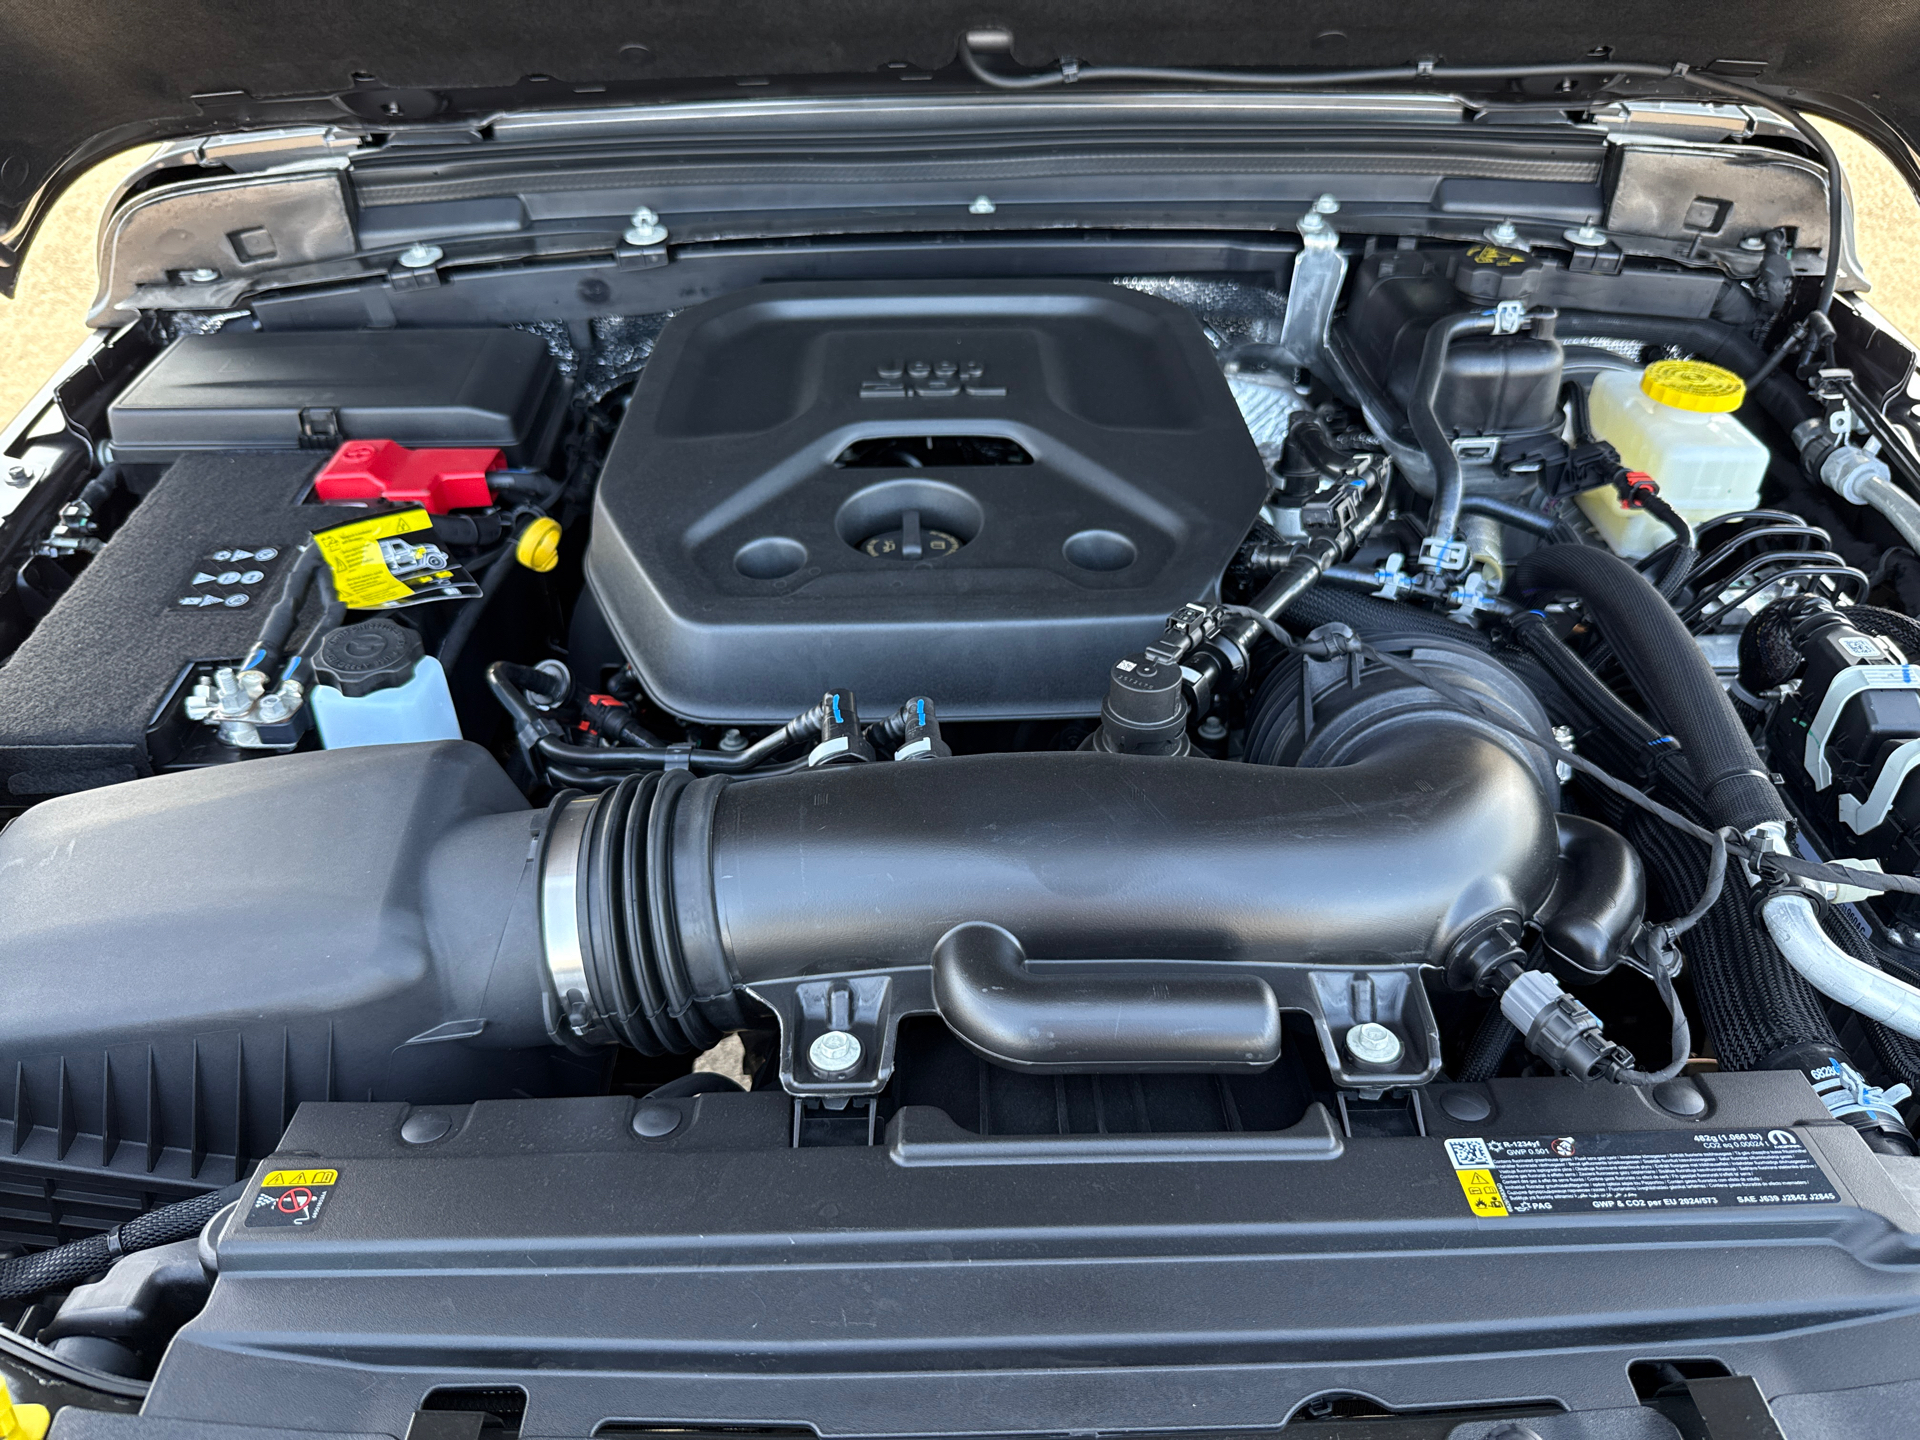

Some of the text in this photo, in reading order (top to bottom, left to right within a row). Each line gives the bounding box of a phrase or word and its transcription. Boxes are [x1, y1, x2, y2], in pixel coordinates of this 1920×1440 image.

[1502, 1140, 1541, 1149] R-1234yf
[1781, 1194, 1808, 1202] J2842
[1532, 1202, 1553, 1210] PAG
[1592, 1200, 1615, 1208] GWP
[1625, 1199, 1646, 1207] CO2
[1647, 1199, 1662, 1208] per
[1662, 1198, 1677, 1206] EU
